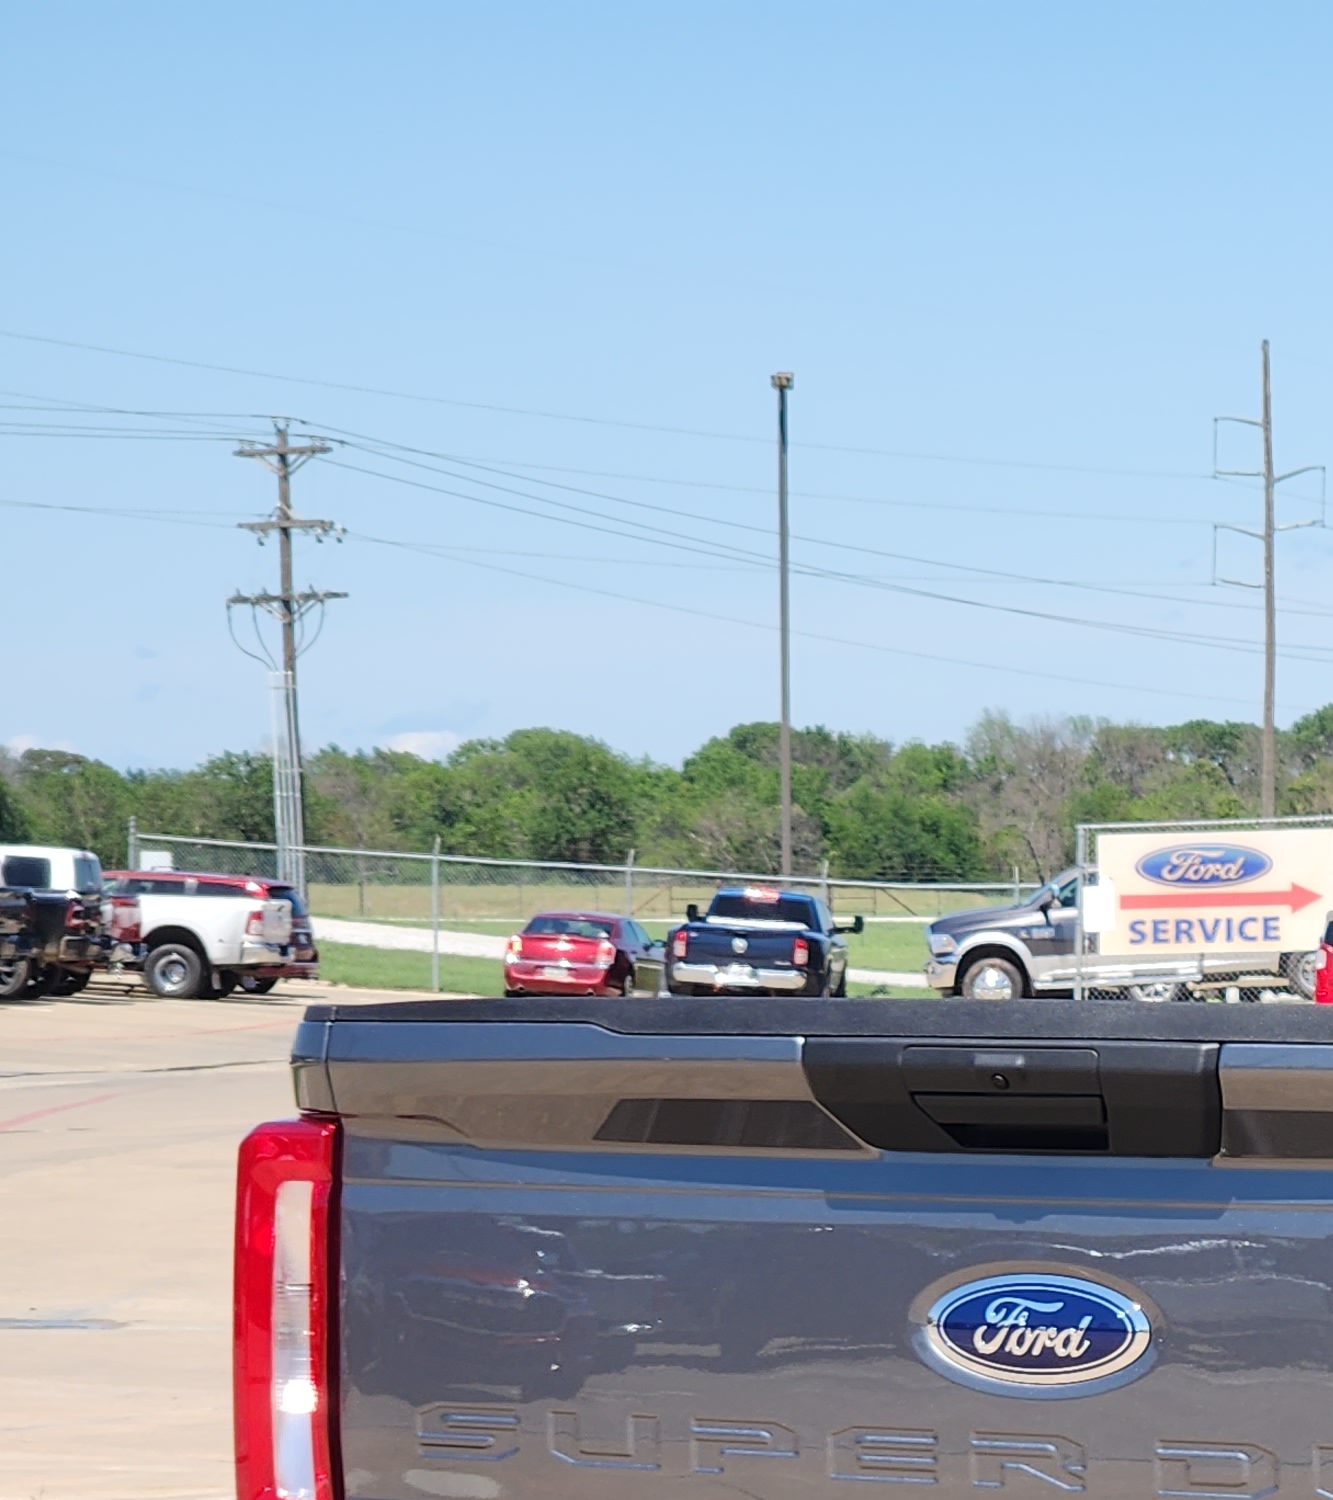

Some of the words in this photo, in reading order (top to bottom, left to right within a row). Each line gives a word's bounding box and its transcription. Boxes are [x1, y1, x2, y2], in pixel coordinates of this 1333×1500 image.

[1160, 849, 1244, 882] Ford
[1128, 916, 1281, 945] SERVICE
[972, 1296, 1094, 1358] Ford
[415, 1401, 1087, 1492] SUPER
